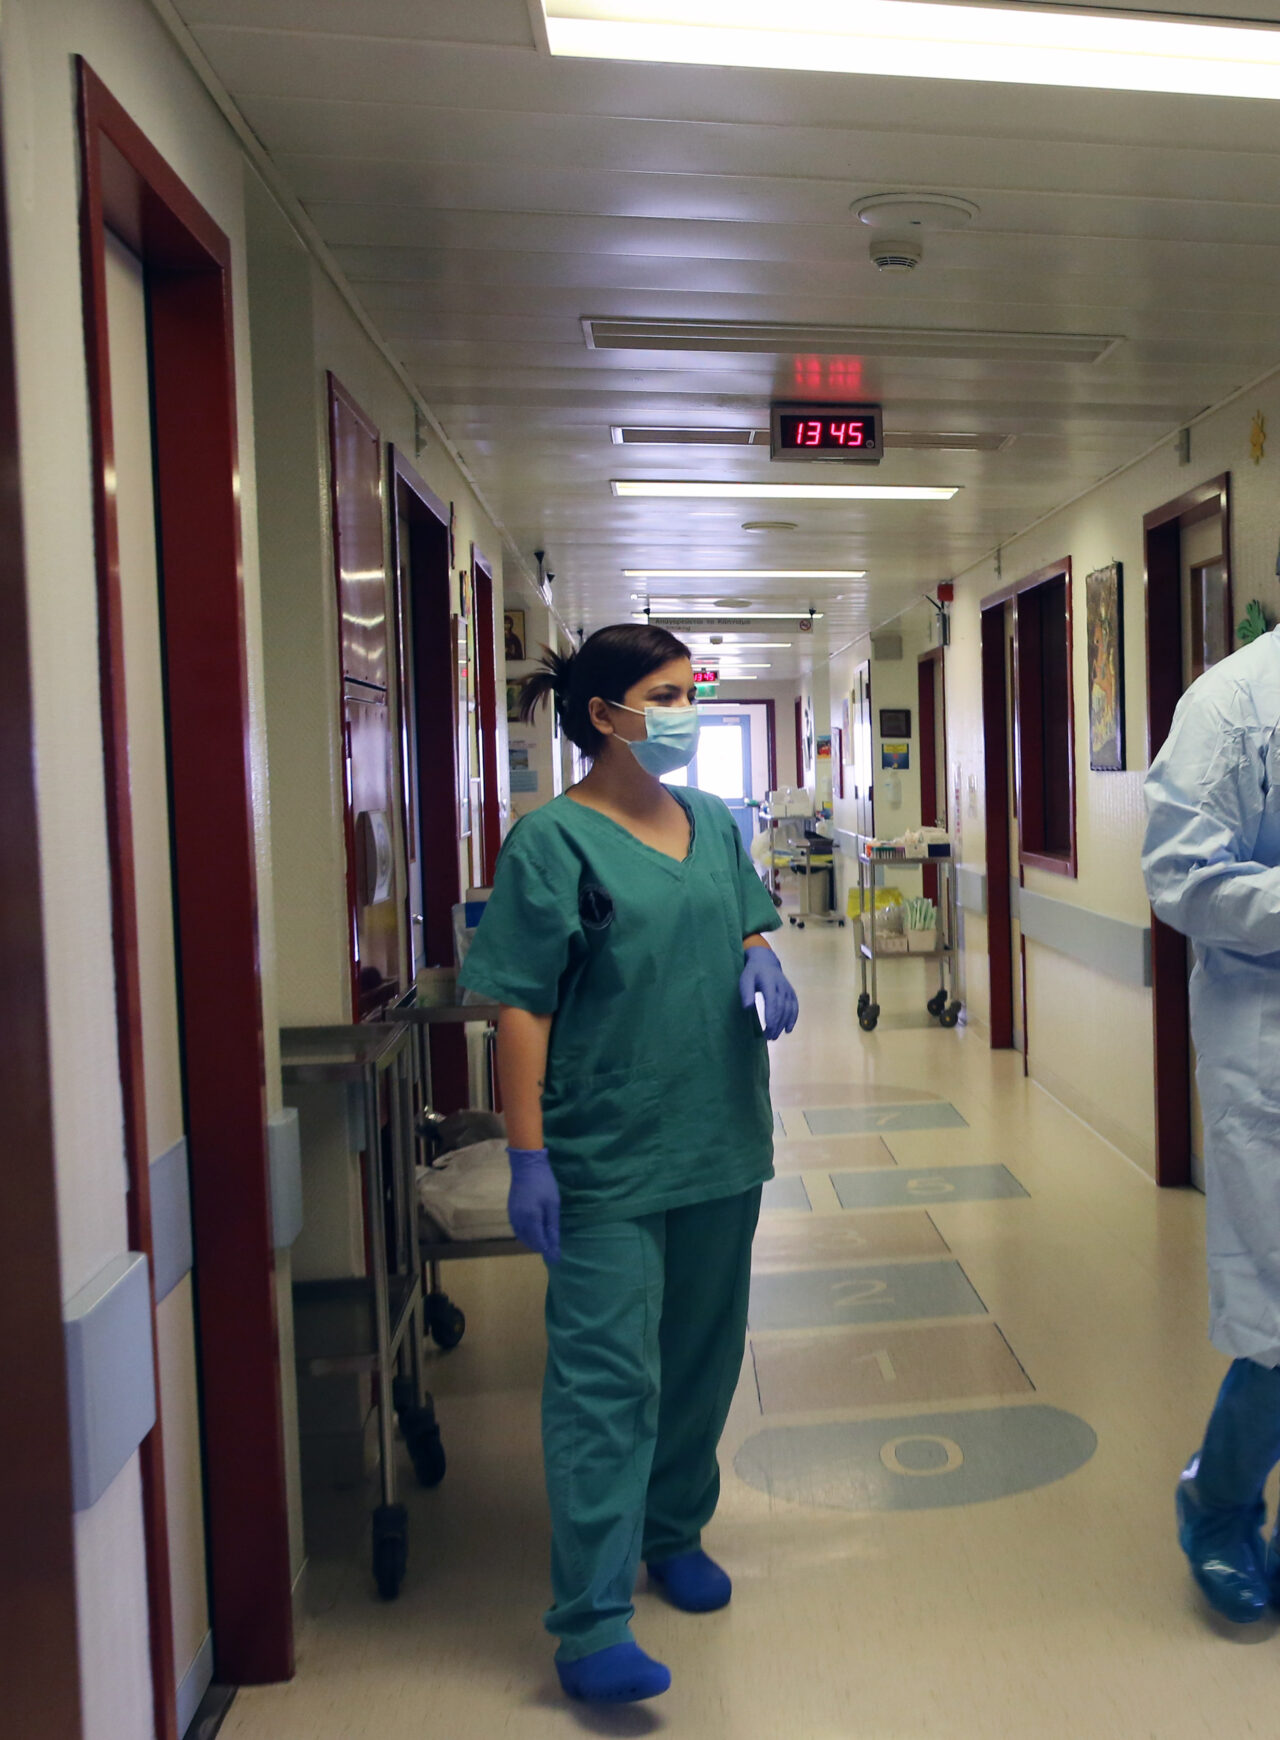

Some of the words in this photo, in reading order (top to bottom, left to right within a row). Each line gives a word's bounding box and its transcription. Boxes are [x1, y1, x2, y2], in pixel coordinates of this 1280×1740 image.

[796, 421, 822, 446] 13
[830, 421, 864, 446] 45
[906, 1176, 956, 1196] 5
[829, 1278, 896, 1307] 2
[851, 1349, 898, 1384] 1
